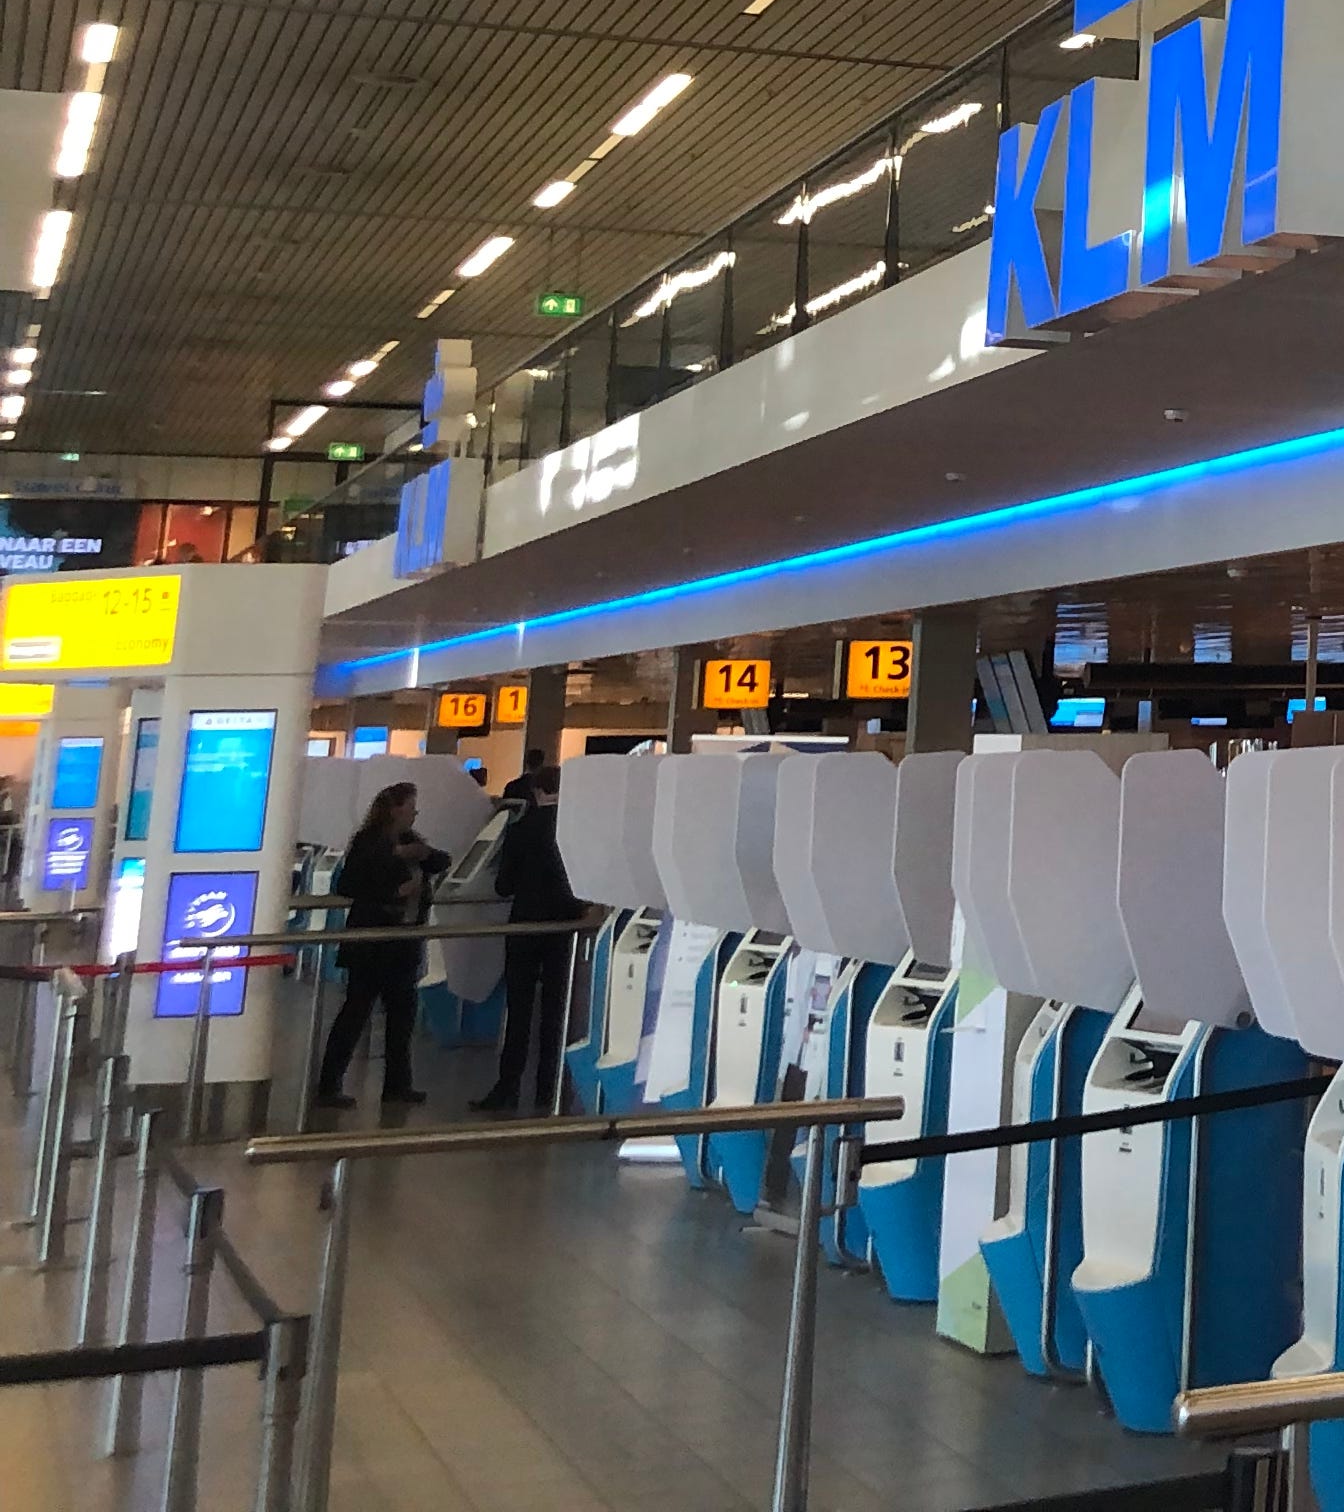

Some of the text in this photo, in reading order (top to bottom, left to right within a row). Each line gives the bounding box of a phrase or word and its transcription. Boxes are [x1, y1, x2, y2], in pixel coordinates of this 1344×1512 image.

[60, 538, 102, 553] EEN
[864, 645, 911, 680] 13
[718, 663, 759, 693] 14
[450, 695, 478, 717] 16
[508, 689, 520, 711] 1
